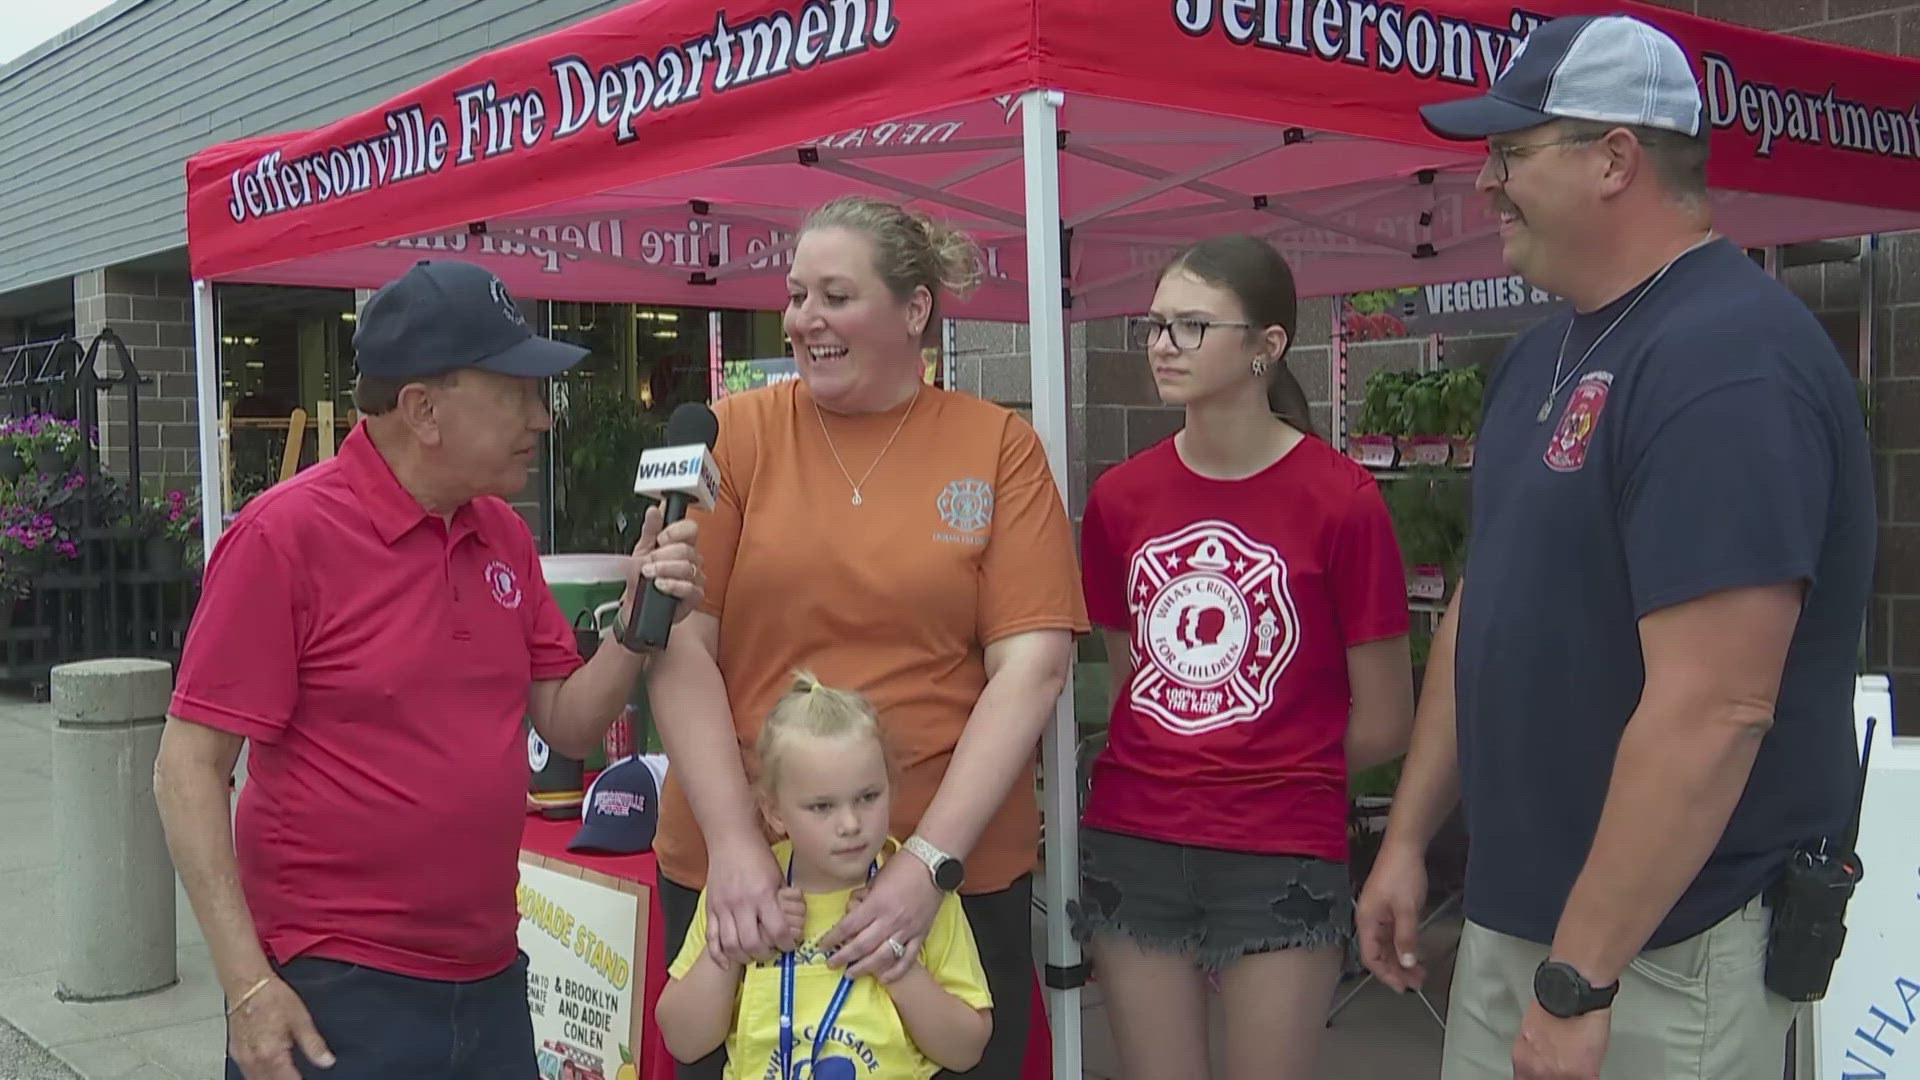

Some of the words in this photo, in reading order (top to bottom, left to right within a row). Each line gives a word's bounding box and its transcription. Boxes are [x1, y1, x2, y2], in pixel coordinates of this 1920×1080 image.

[1174, 0, 1549, 86] effersonvi
[1701, 51, 1920, 158] Department
[229, 104, 449, 223] Jeffersonville
[455, 80, 545, 166] Fire
[550, 0, 900, 146] Department
[1424, 275, 1525, 315] VEGGIES
[1156, 583, 1192, 619] WHAS
[1196, 579, 1242, 624] CRUSADE
[1155, 636, 1177, 665] FOR
[1177, 641, 1239, 678] CHILDREN
[1166, 687, 1197, 701] 100%
[1200, 690, 1224, 704] FOR
[1168, 698, 1188, 712] THE
[1190, 700, 1218, 714] KIDS
[573, 924, 629, 992] STAND
[529, 1001, 545, 1018] LINE
[554, 976, 562, 993] &
[564, 979, 618, 1013] BROOKLYN
[558, 997, 579, 1021] AND
[580, 1005, 612, 1033] ADDIE
[563, 1021, 604, 1051] CONLEN
[803, 1024, 880, 1074] CUSADE
